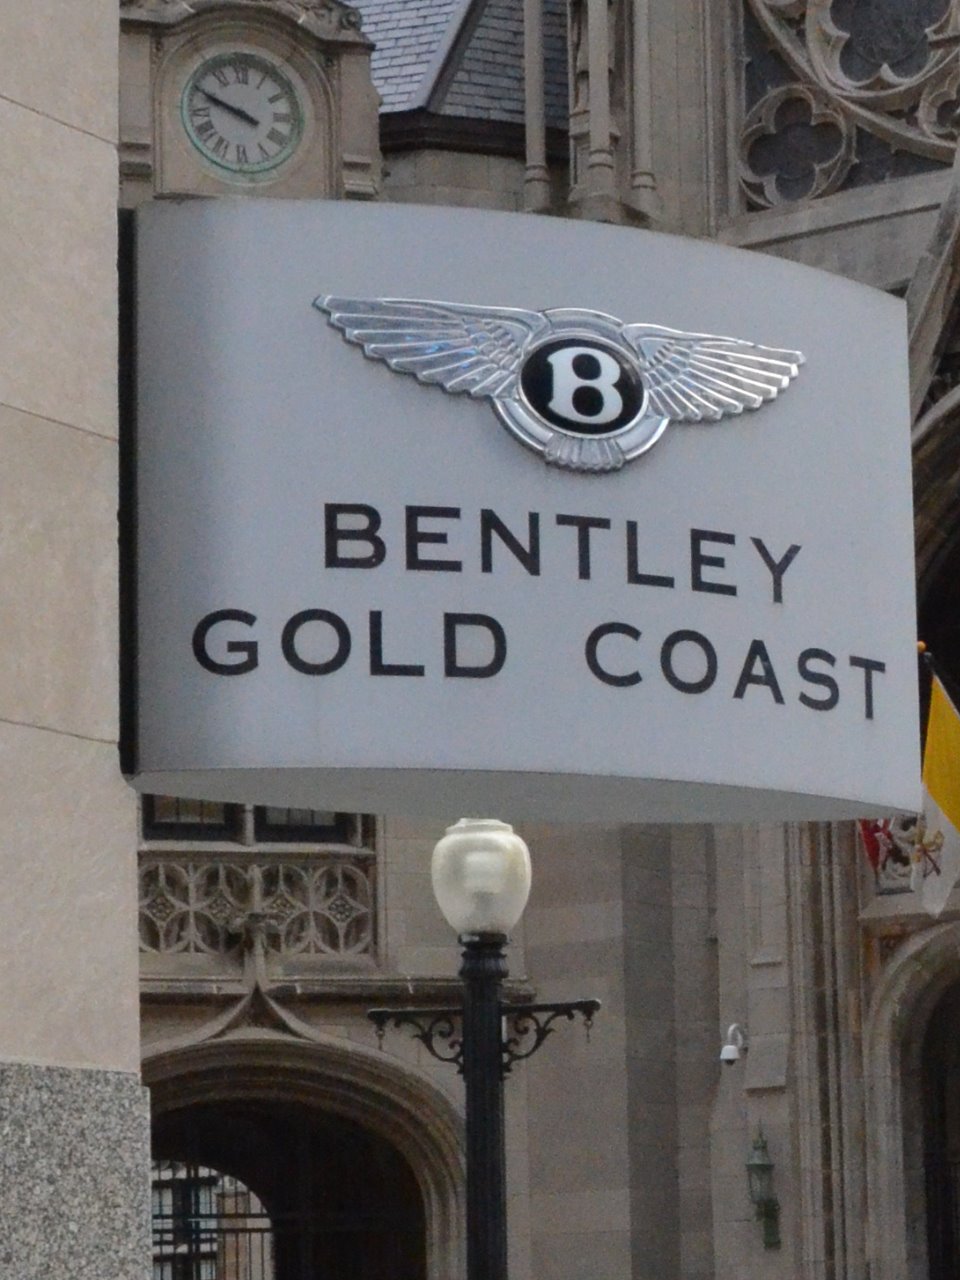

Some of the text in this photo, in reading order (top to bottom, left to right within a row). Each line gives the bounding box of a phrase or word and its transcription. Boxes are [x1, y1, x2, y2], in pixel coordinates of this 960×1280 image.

[323, 502, 802, 604] BENTLEY
[191, 608, 887, 720] GOLD COAST
